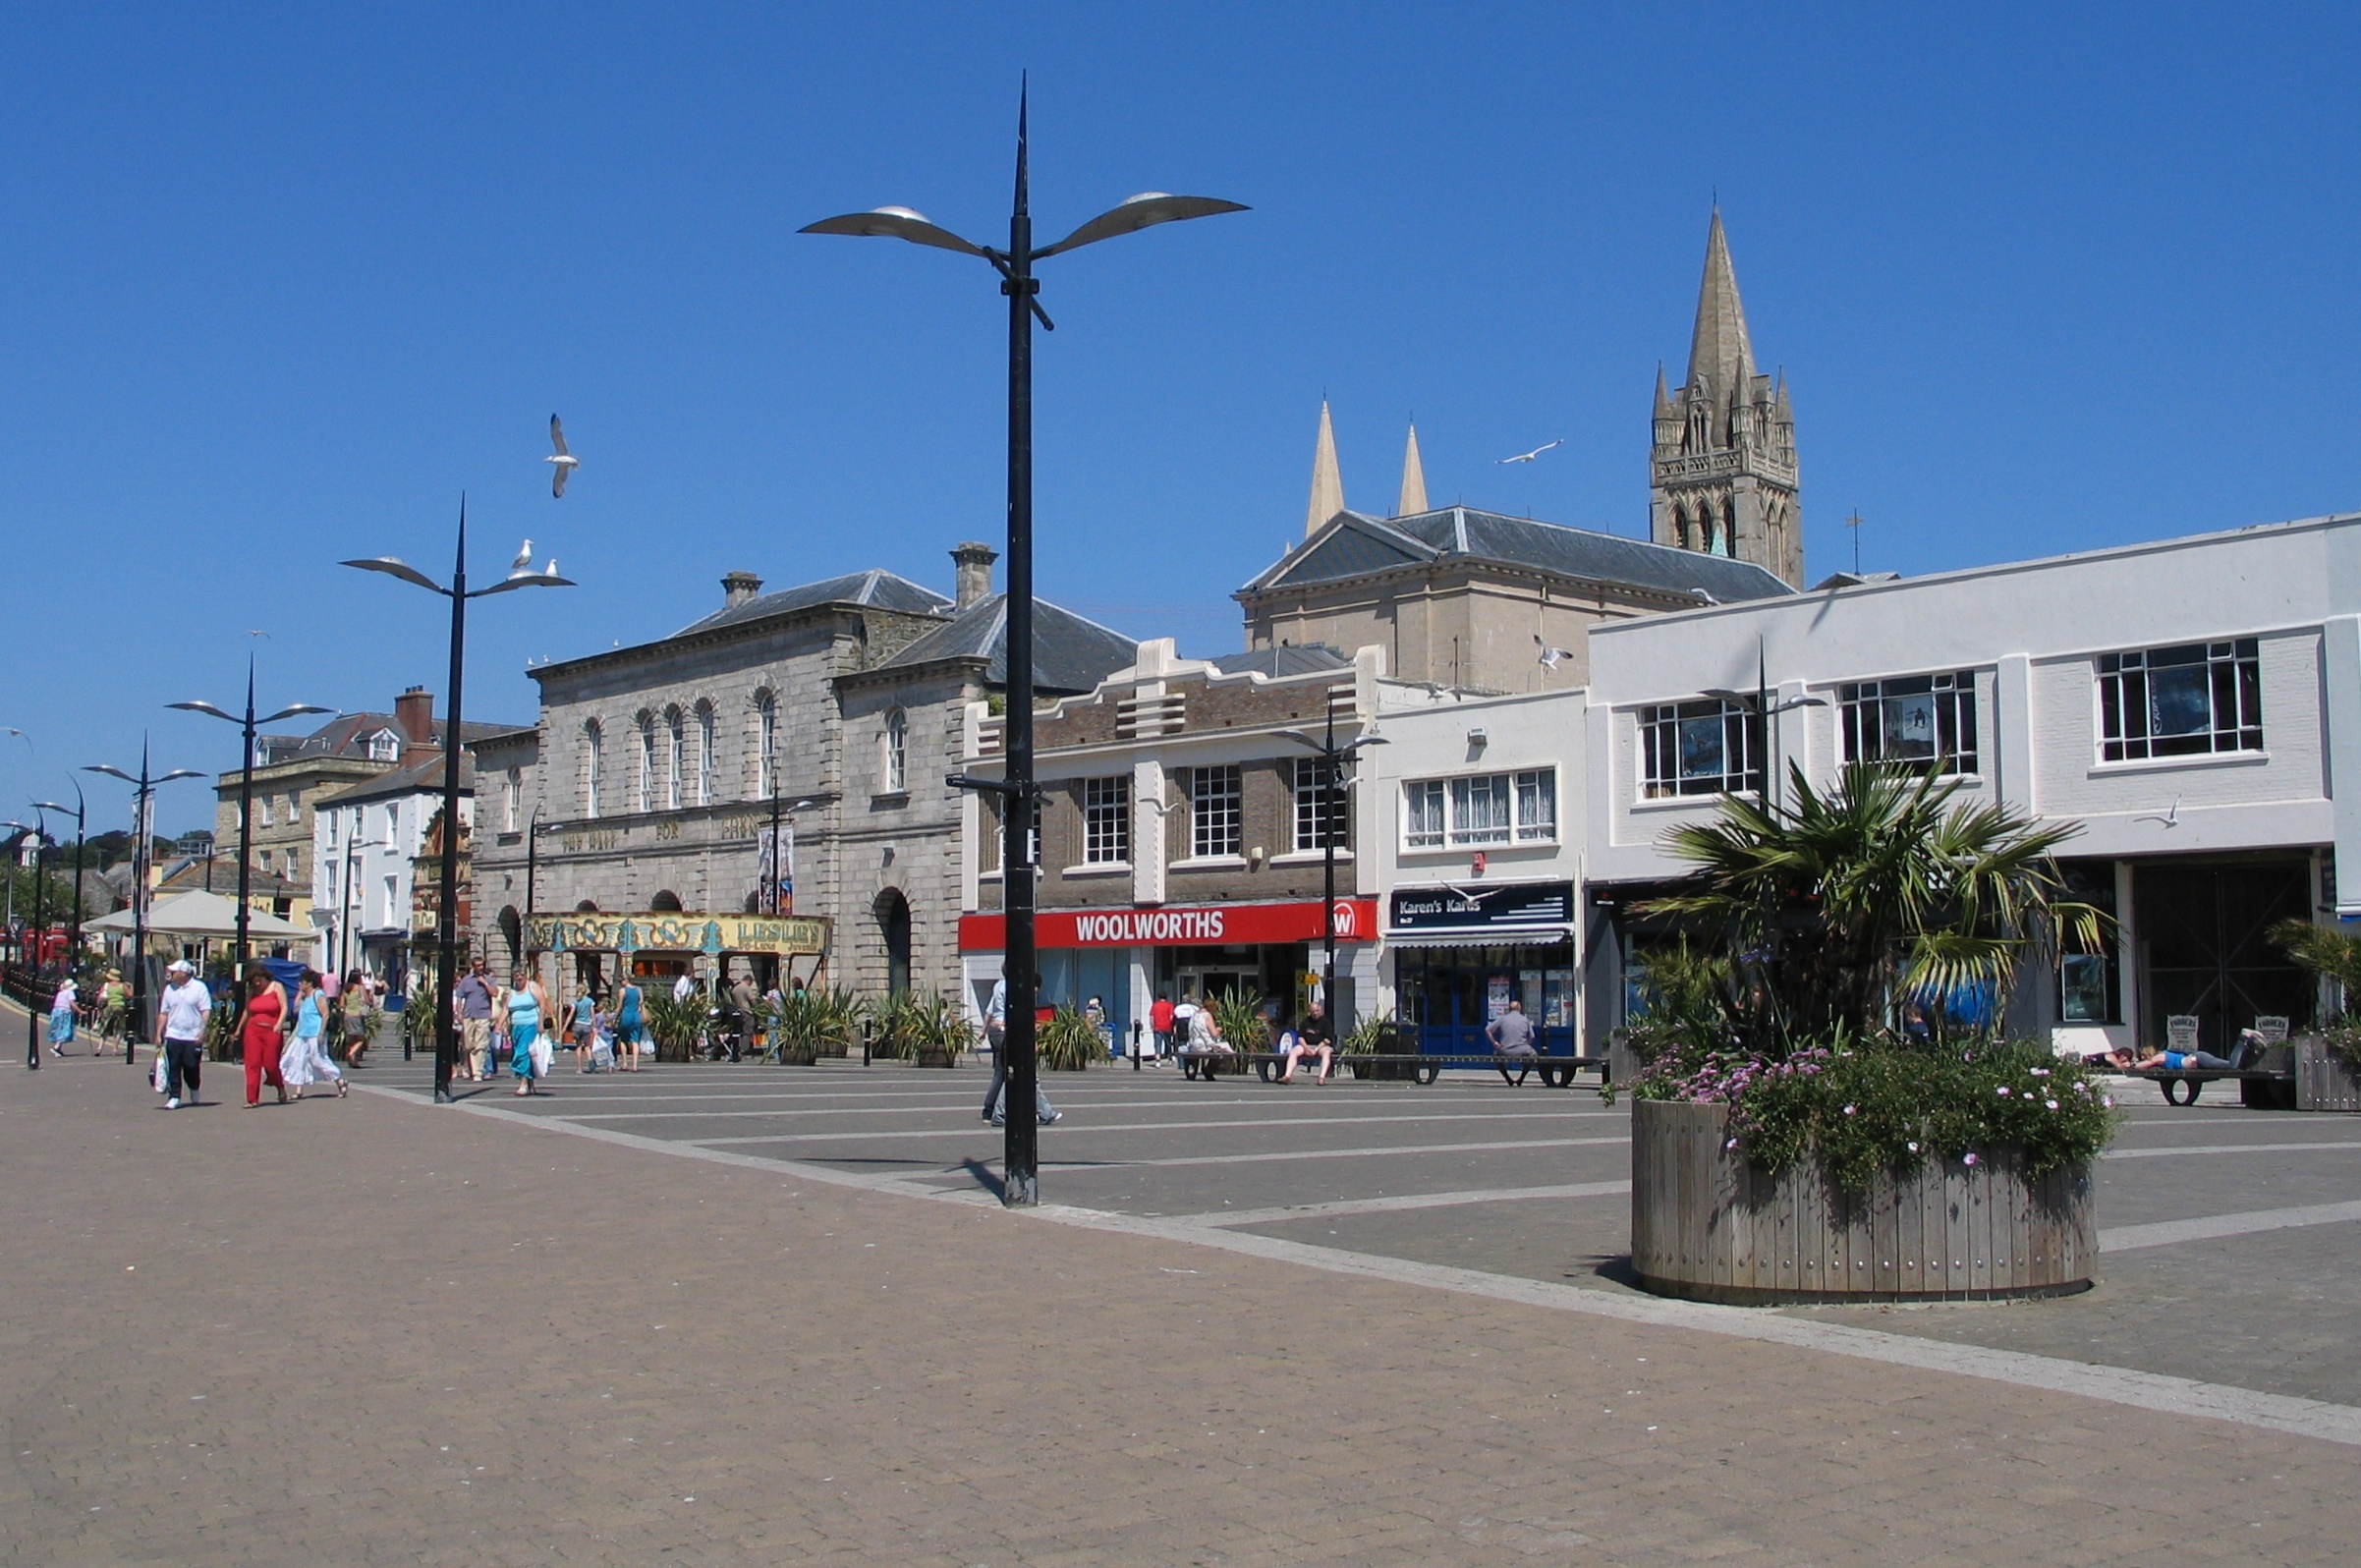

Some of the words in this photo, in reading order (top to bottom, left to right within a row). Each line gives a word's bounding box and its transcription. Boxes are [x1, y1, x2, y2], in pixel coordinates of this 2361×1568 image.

[655, 820, 680, 841] FOR
[1400, 901, 1441, 915] Karen's
[738, 923, 819, 943] LESLIE'S
[1076, 911, 1223, 941] WOOLWORTHS
[1333, 913, 1352, 933] W
